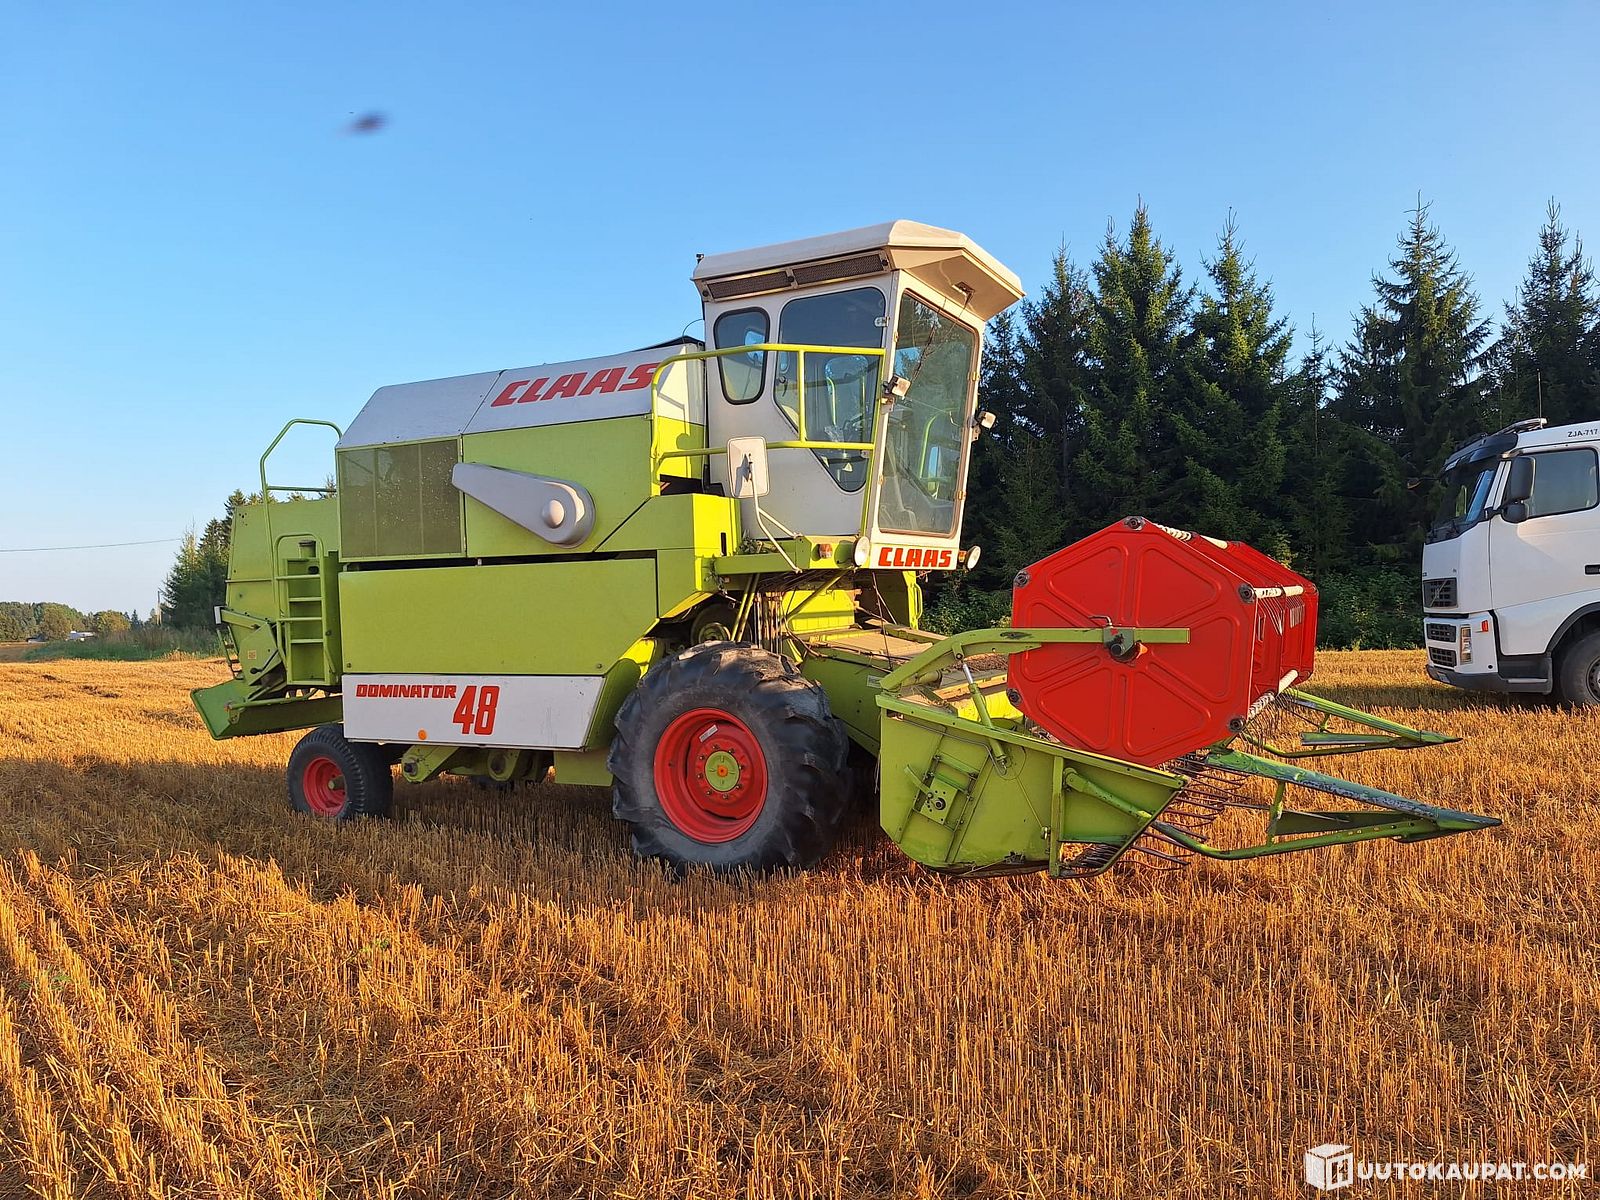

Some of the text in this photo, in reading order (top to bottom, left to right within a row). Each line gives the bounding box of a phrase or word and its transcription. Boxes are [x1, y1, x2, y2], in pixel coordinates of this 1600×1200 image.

[490, 362, 658, 407] CLAAS
[1567, 428, 1598, 438] ZJA-717
[878, 546, 952, 568] CLAAS
[356, 684, 500, 736] DOMINATOR 48
